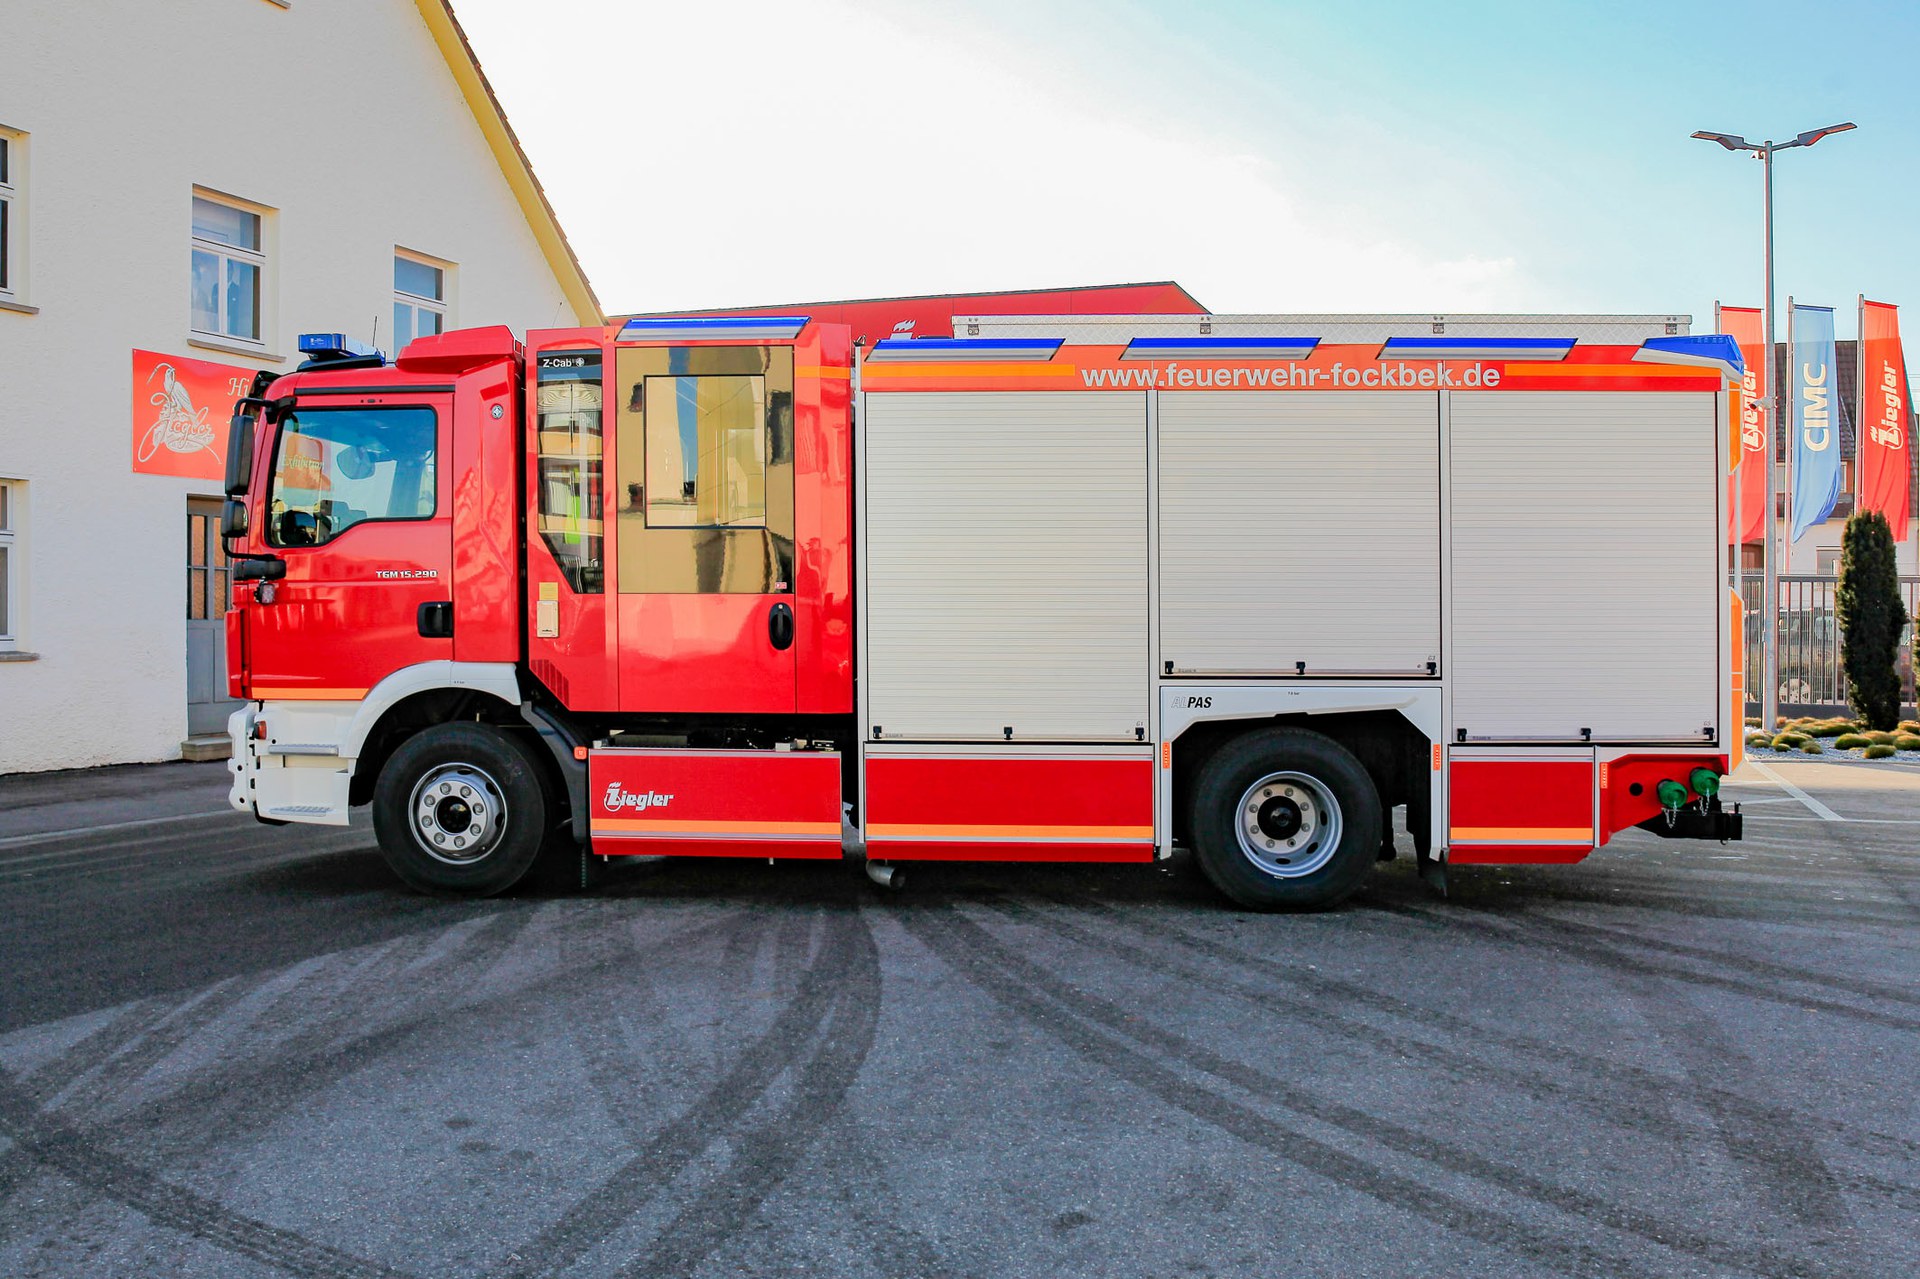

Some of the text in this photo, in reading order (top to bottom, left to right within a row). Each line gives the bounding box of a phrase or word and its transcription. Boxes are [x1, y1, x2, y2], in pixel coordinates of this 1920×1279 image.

[543, 358, 572, 368] Z-Cab
[1081, 362, 1501, 388] www.feuerwehr-fockbek.de
[1803, 363, 1830, 452] CIMC
[1871, 360, 1904, 450] Ziegler
[376, 570, 438, 579] TGM 15.290
[1171, 696, 1213, 709] ALPAS
[603, 782, 674, 812] Ziegler
